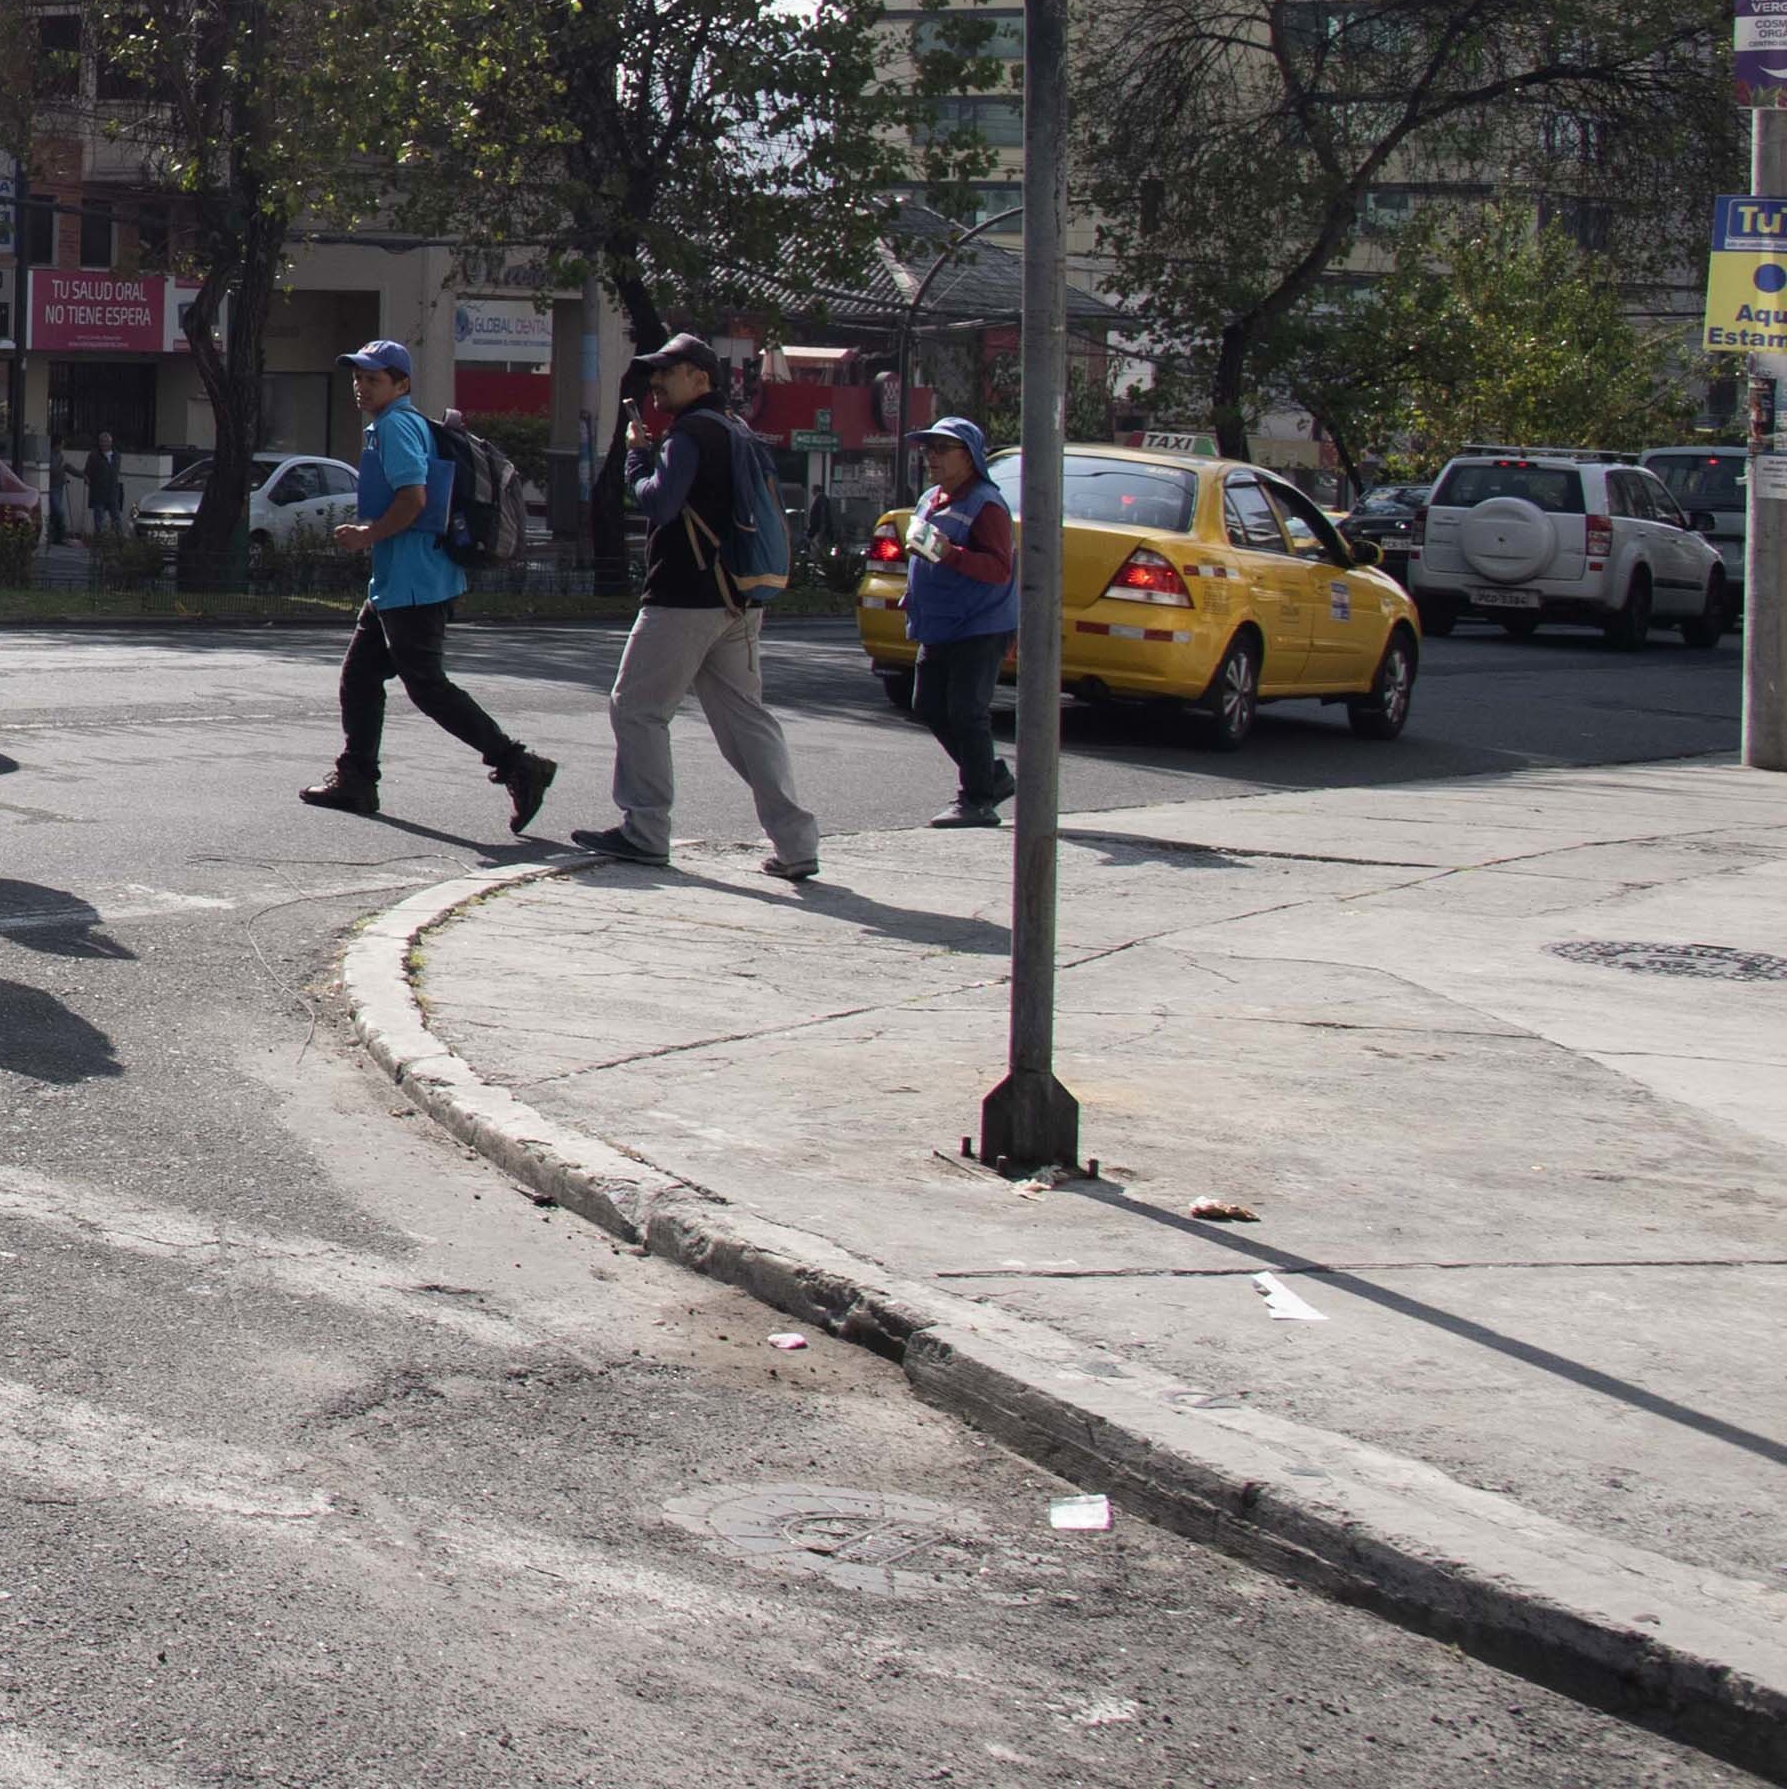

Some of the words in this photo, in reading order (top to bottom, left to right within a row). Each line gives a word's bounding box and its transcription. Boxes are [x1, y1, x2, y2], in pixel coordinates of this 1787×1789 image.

[52, 279, 69, 299] TU
[71, 280, 113, 301] SALUD
[115, 282, 147, 301] ORAL
[45, 305, 64, 324] NO
[66, 306, 103, 325] TIENE
[105, 307, 151, 326] ESPERA
[475, 317, 513, 334] GLOBAL
[515, 318, 551, 337] DENTAL
[1147, 434, 1192, 450] TAXI
